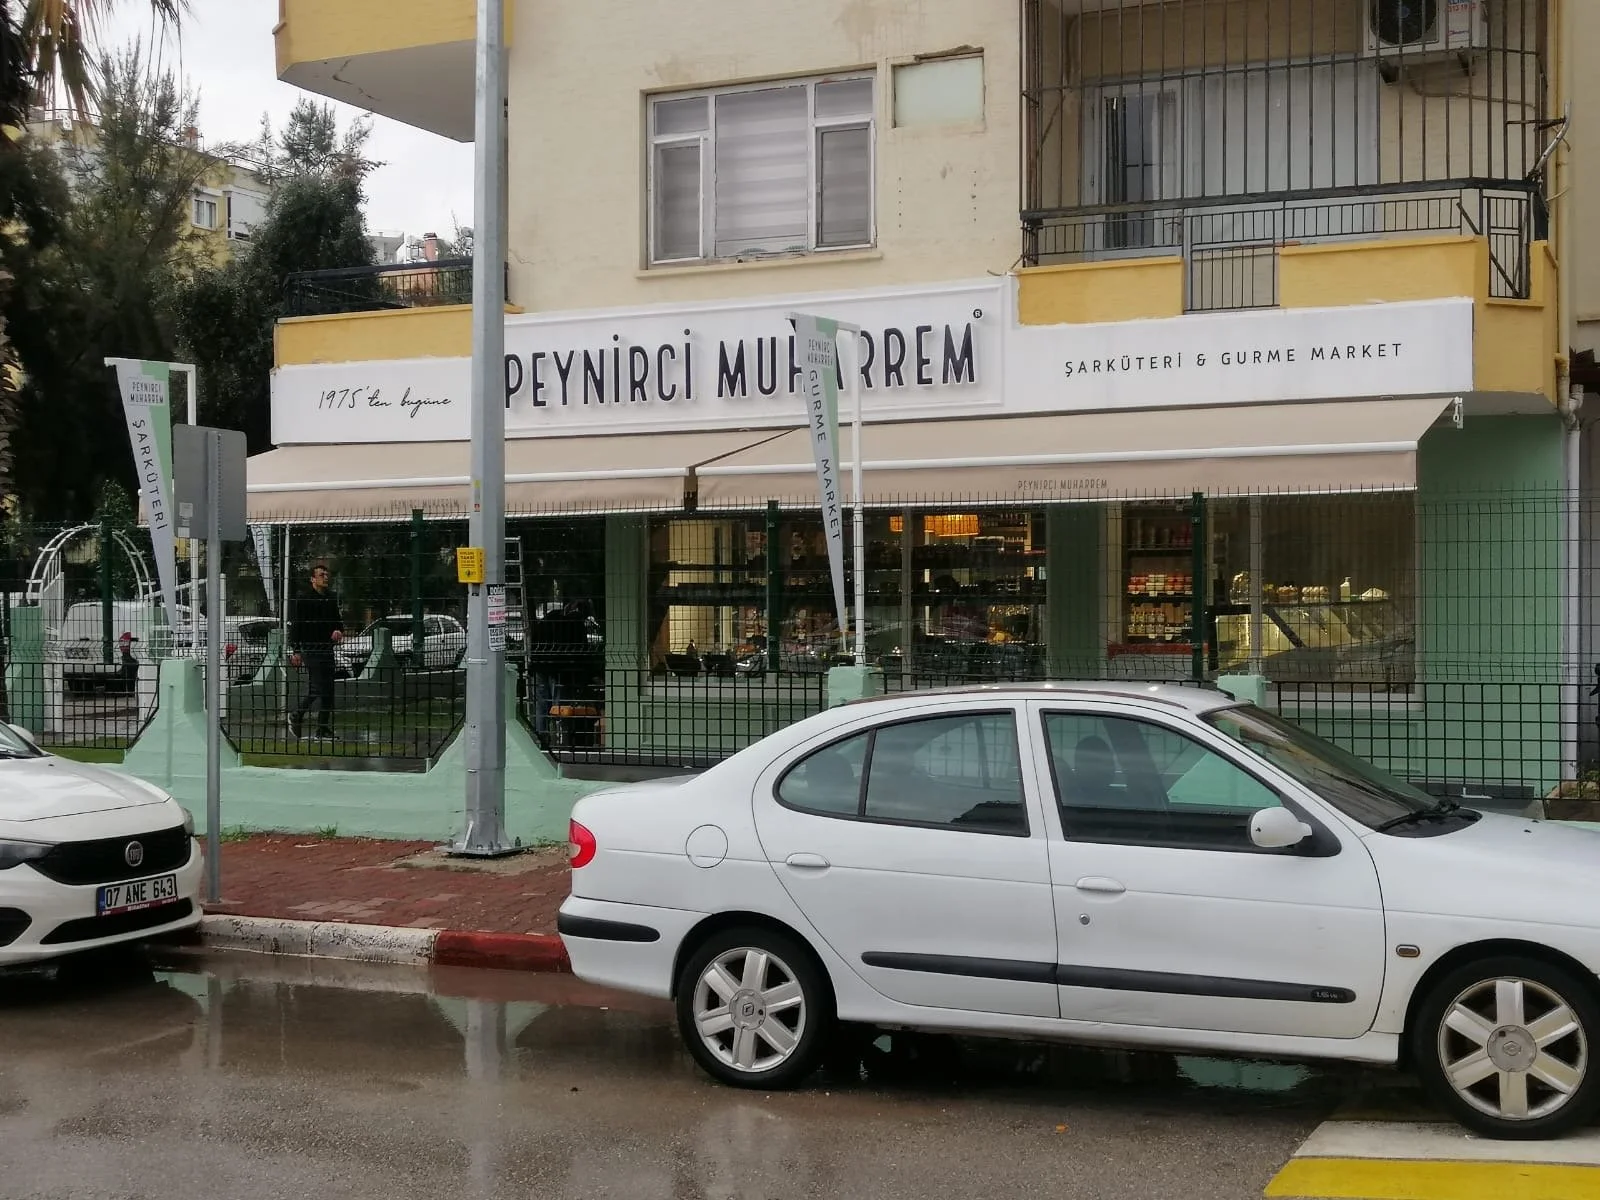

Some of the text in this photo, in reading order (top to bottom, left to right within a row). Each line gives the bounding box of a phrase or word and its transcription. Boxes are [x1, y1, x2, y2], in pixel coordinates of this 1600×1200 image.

[504, 328, 693, 408] PEYNİRCİ
[1065, 343, 1401, 377] ŞARKÜTERİ & GURME MARKET
[319, 385, 392, 409] 1975'ten
[809, 370, 841, 540] GURME MARKET
[1060, 479, 1107, 490] MUHARREM
[106, 877, 173, 907] 07 ANE 643
